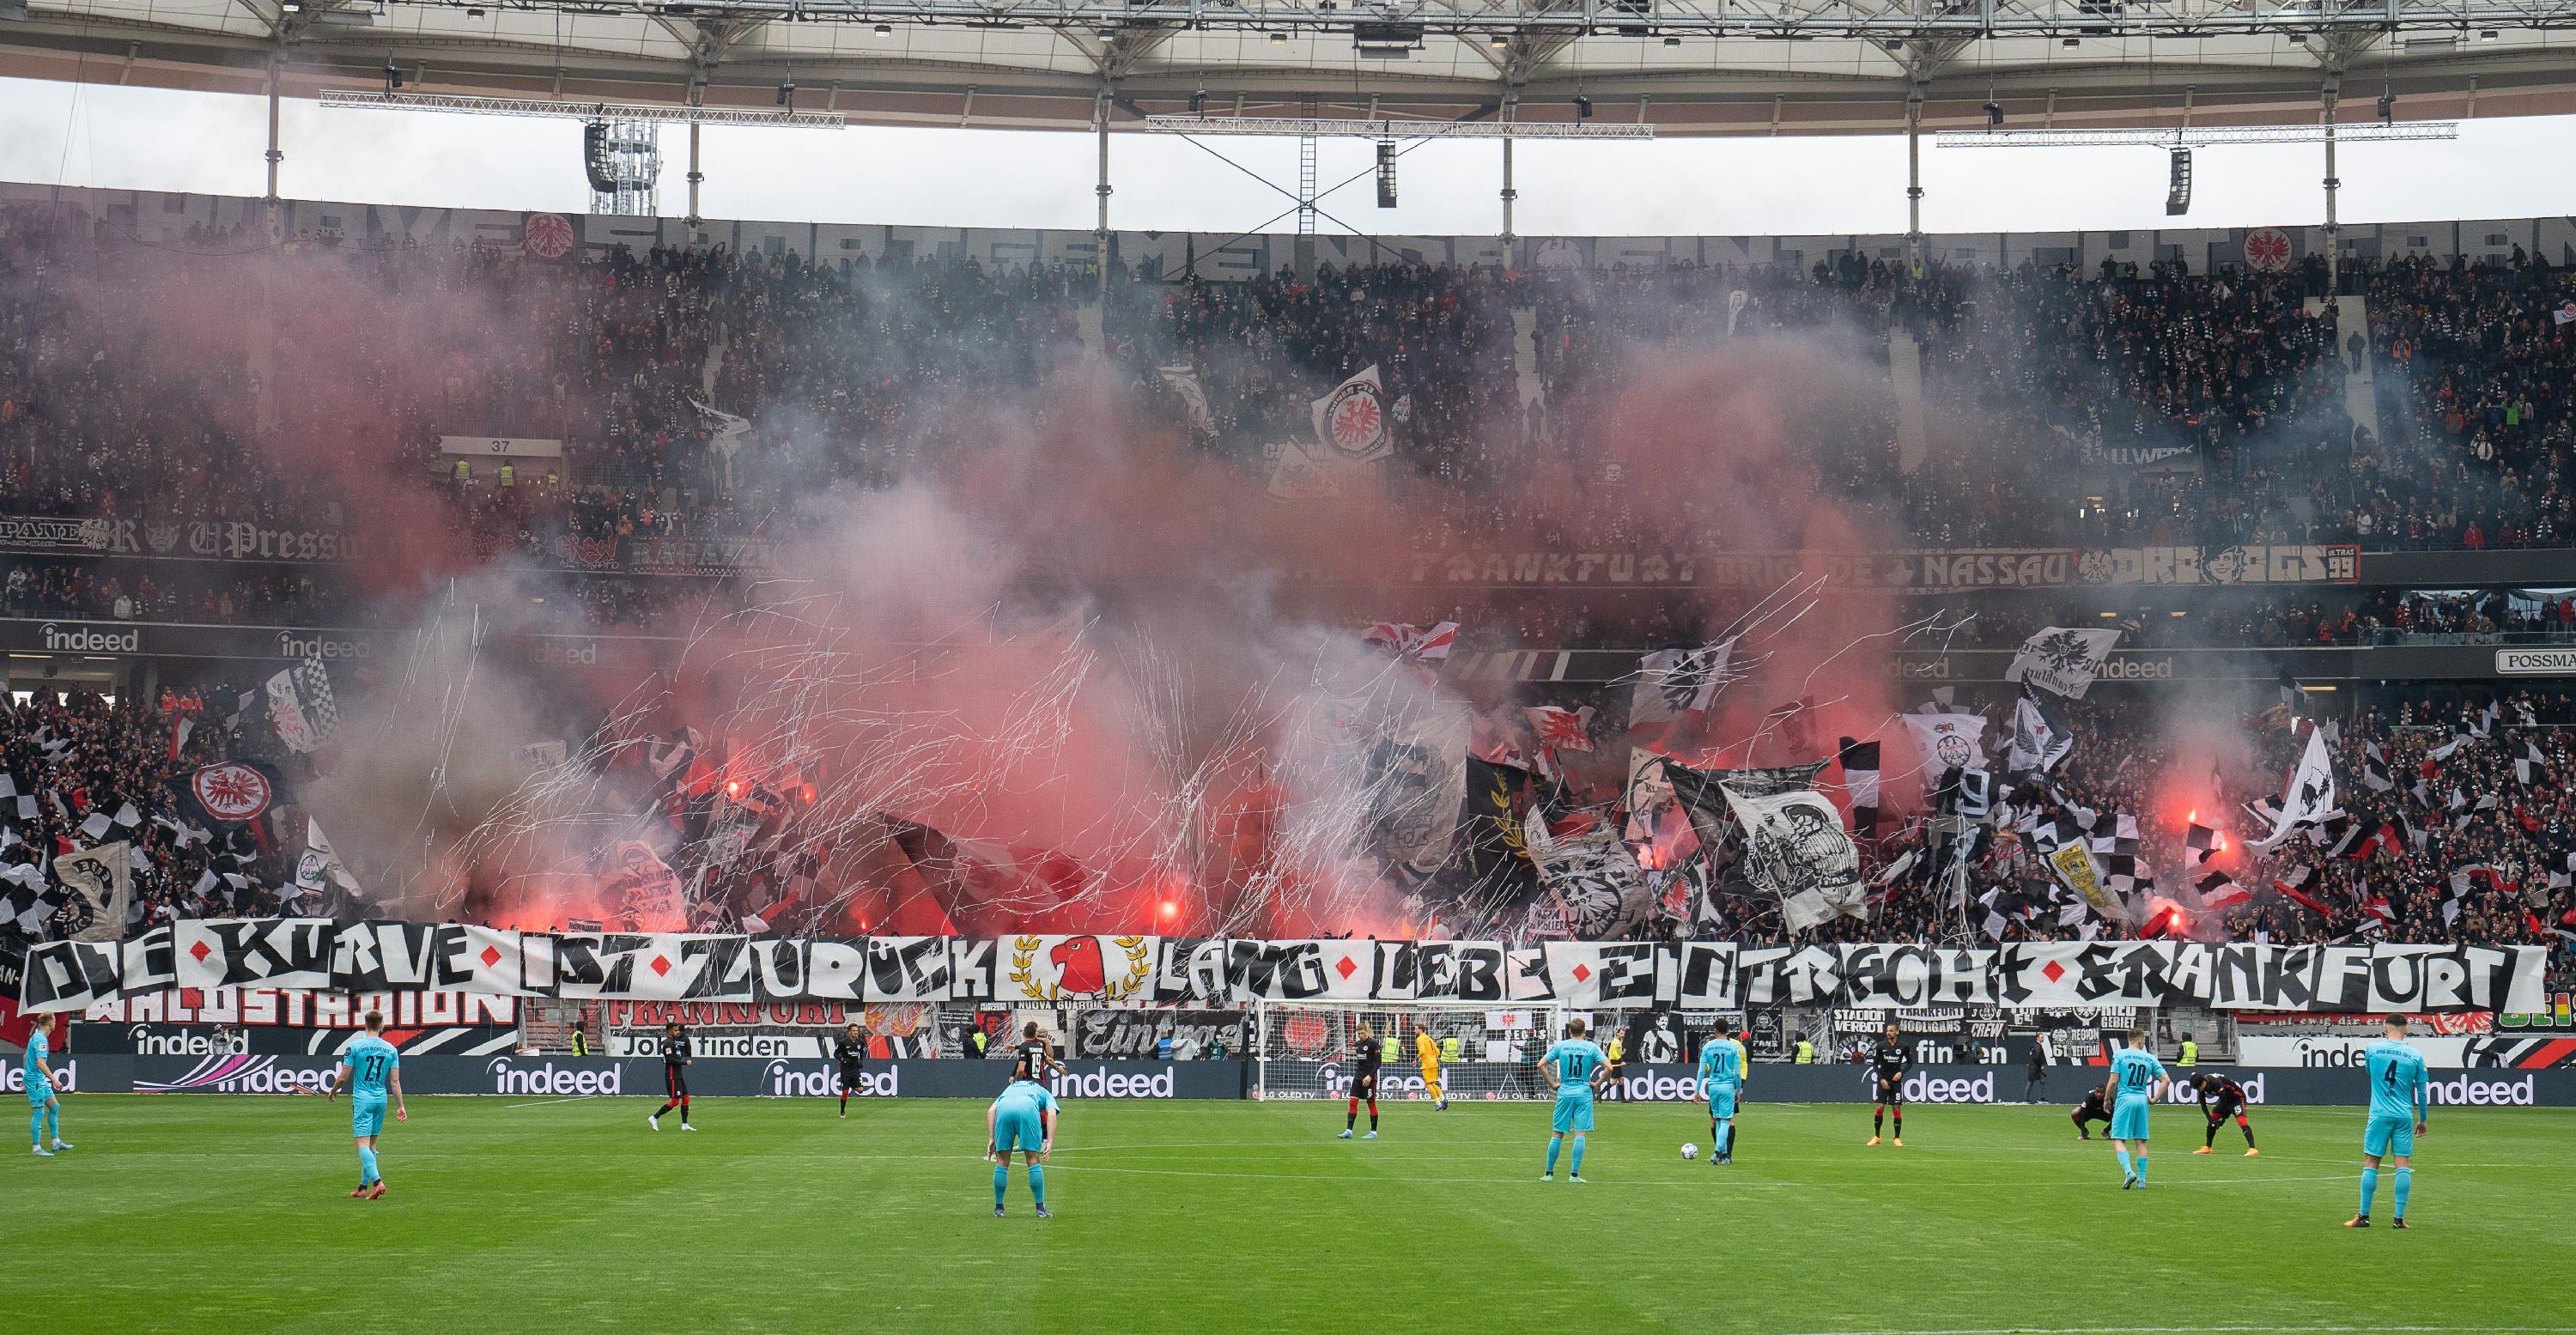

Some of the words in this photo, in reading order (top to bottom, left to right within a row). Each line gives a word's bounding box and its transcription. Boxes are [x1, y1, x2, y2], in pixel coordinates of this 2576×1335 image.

[491, 441, 510, 452] 37
[1924, 555, 2067, 586] NASSAU
[2328, 557, 2354, 579] 99
[40, 623, 138, 652] indeed
[277, 632, 370, 658] indeed
[25, 928, 176, 1009] DIE
[207, 919, 475, 987] KURVE
[524, 934, 653, 994] IST
[678, 936, 995, 1000] ZURÜCK
[1160, 939, 1329, 999] LANG
[1376, 943, 1553, 1001] LEBE
[1598, 943, 2037, 1004] EINTRACHT
[2075, 944, 2506, 1009] FRANKFURT
[1018, 1001, 1052, 1010] NUOVA
[1834, 1009, 1886, 1022] STADION
[1834, 1021, 1885, 1034] VERBOT
[1971, 1022, 2004, 1038] CREW
[2101, 1016, 2136, 1029] GEBIET
[2269, 1016, 2294, 1026] auf
[2300, 1016, 2331, 1028] ewig
[2338, 1016, 2360, 1026] dir
[698, 1036, 788, 1056] finden
[364, 1055, 386, 1082] 27
[1030, 1053, 1041, 1074] 19
[1569, 1054, 1583, 1077] 13
[1712, 1053, 1726, 1074] 21
[2384, 1059, 2398, 1088] 4
[489, 1058, 620, 1095] indeed
[1049, 1064, 1174, 1098] indeed
[2127, 1064, 2147, 1086] 20
